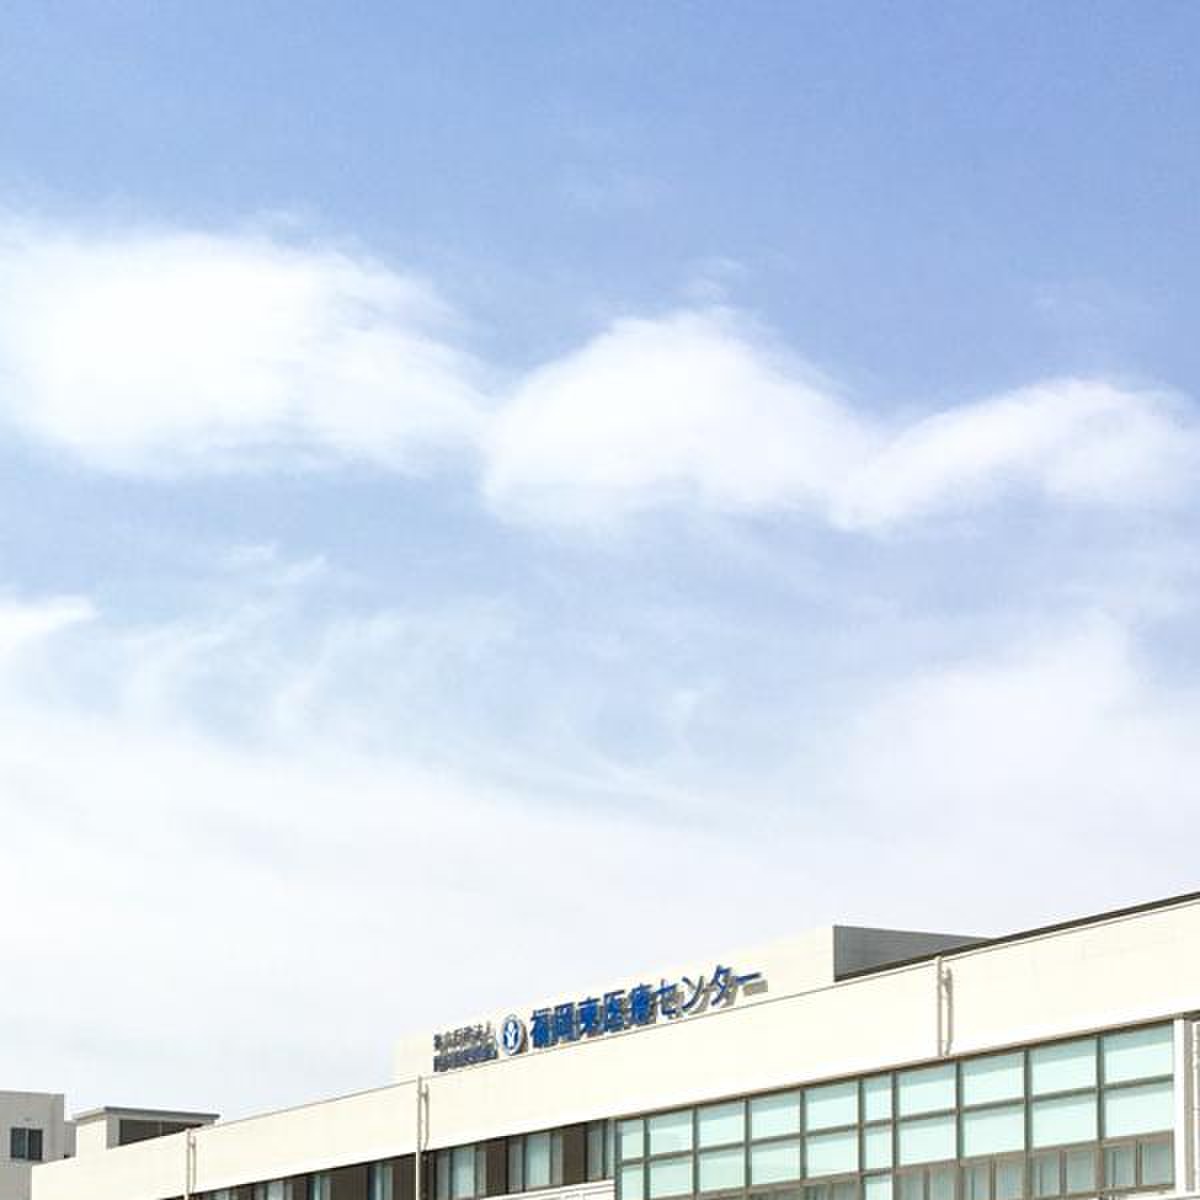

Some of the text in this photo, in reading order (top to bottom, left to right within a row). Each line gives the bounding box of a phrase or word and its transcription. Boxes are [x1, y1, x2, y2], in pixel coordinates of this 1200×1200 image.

[530, 964, 762, 1048] 福岡東医療センター
